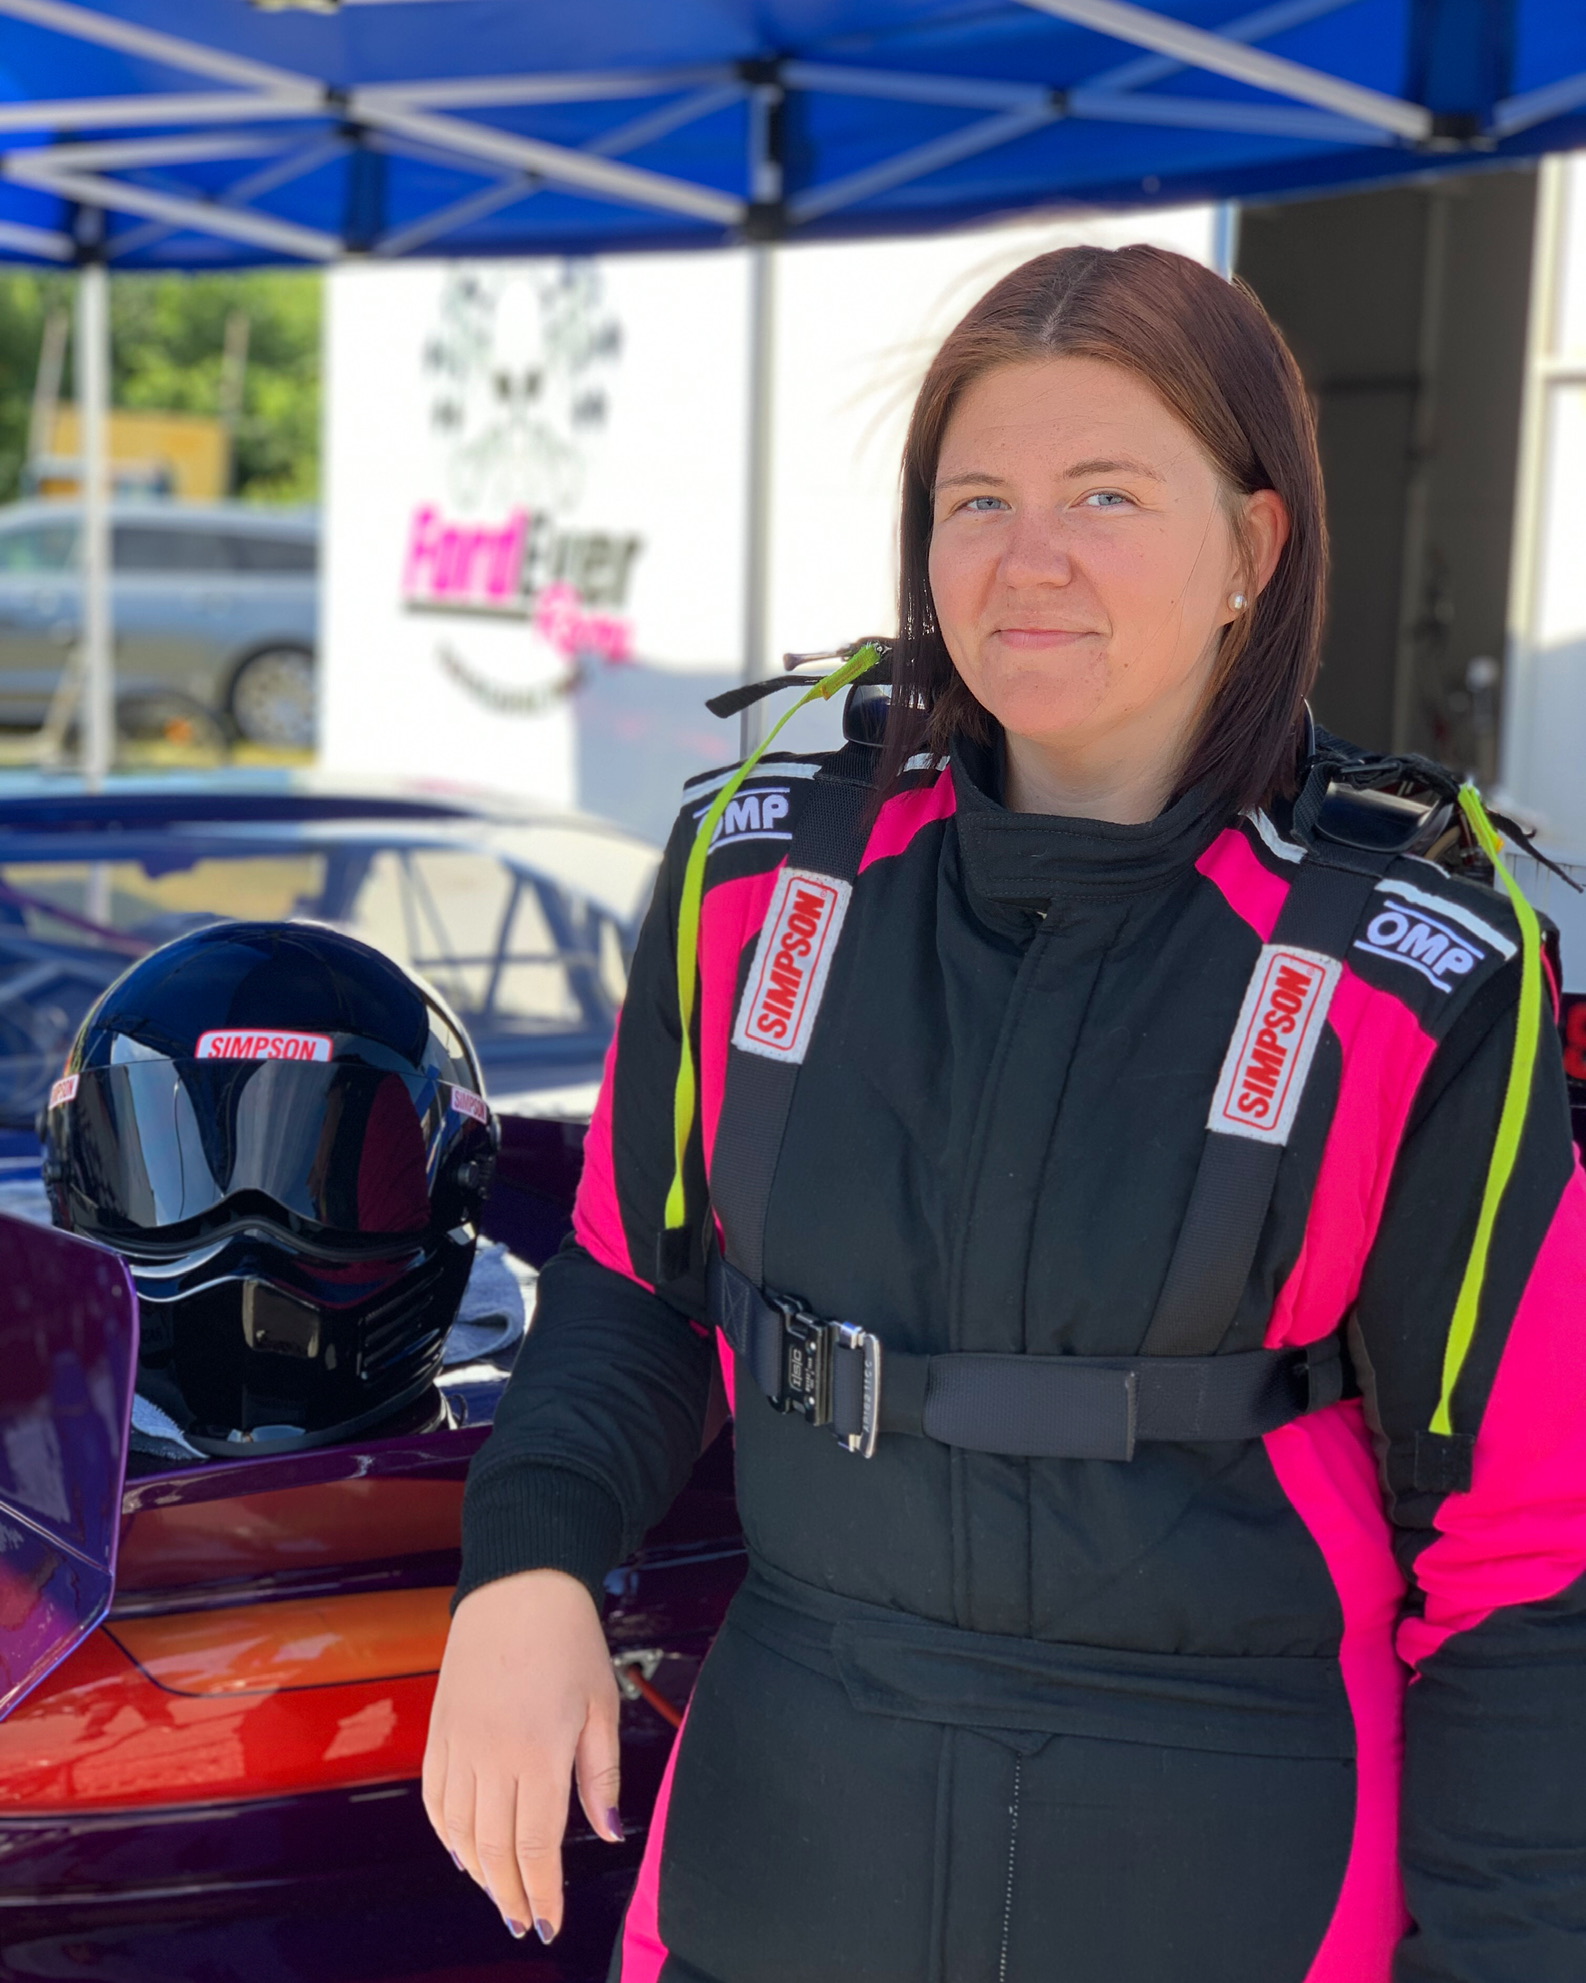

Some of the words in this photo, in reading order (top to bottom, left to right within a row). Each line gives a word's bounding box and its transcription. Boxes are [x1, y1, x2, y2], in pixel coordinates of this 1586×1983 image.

[757, 889, 826, 1039] SIMPSON
[1367, 911, 1474, 976] OMP
[208, 1035, 317, 1061] SIMPSON
[1237, 964, 1312, 1118] SIMPSON
